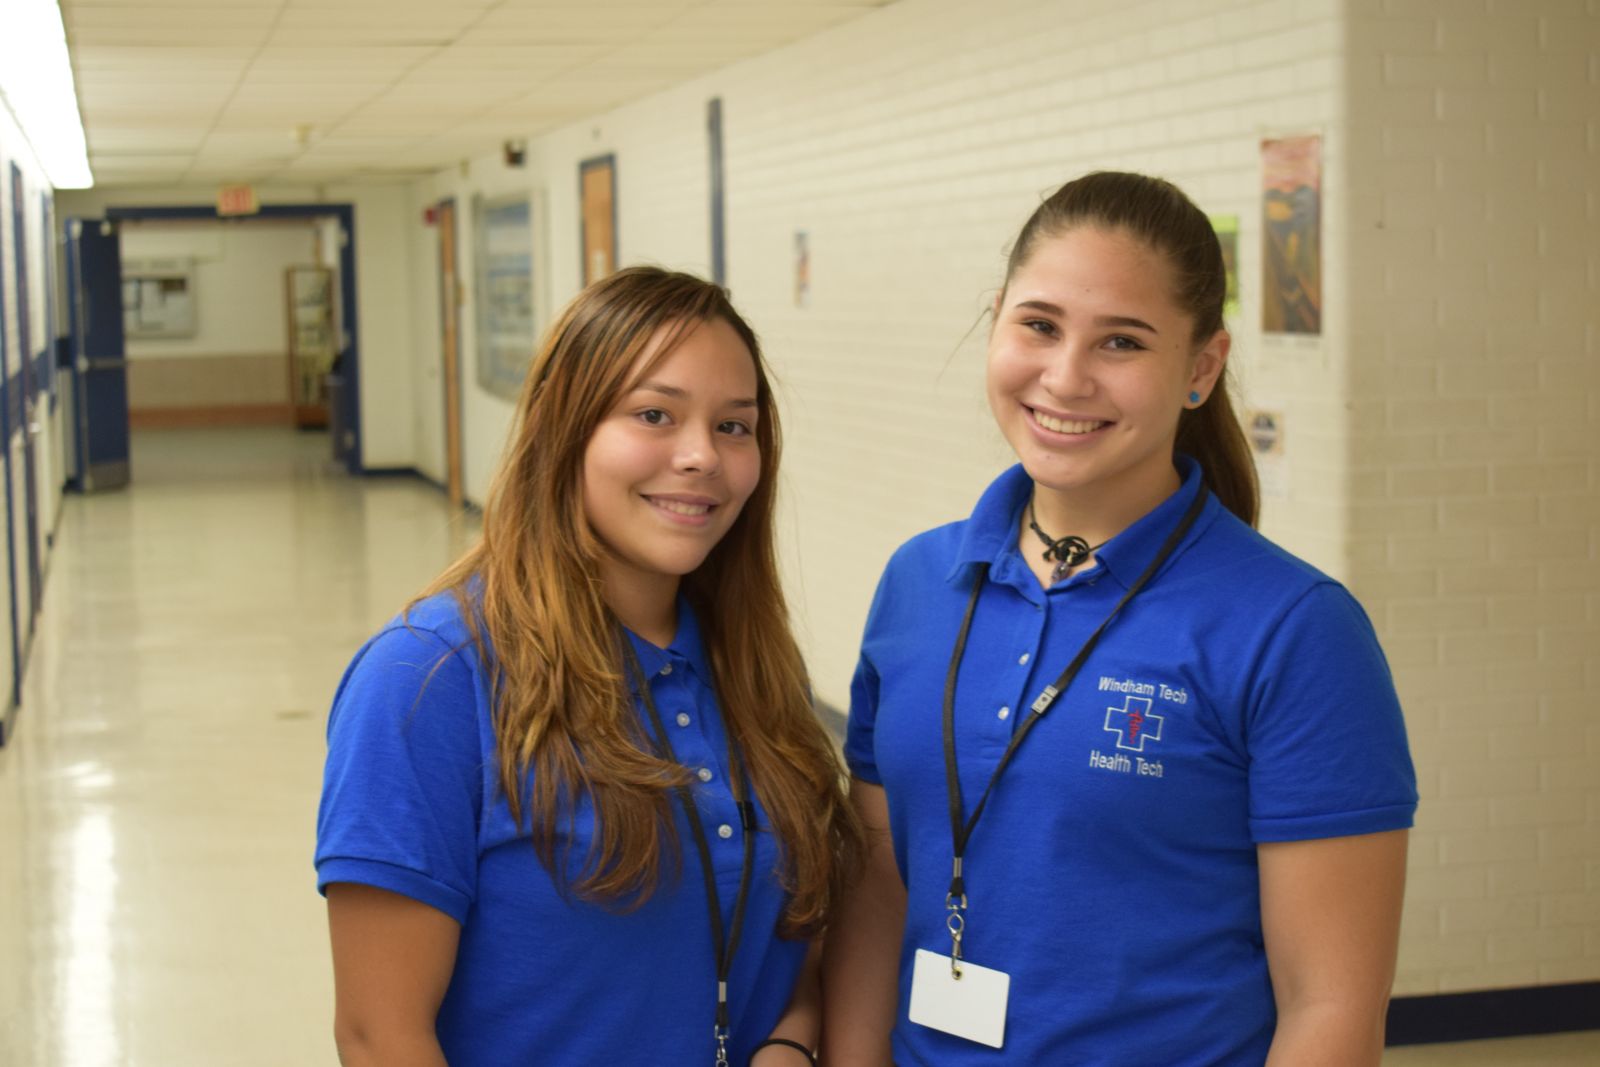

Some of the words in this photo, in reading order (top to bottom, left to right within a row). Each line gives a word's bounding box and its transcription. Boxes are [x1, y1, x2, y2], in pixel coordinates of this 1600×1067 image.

[1098, 677, 1155, 696] Windham
[1159, 684, 1188, 704] Tech
[1089, 750, 1131, 773] Health
[1136, 757, 1163, 778] Tech
